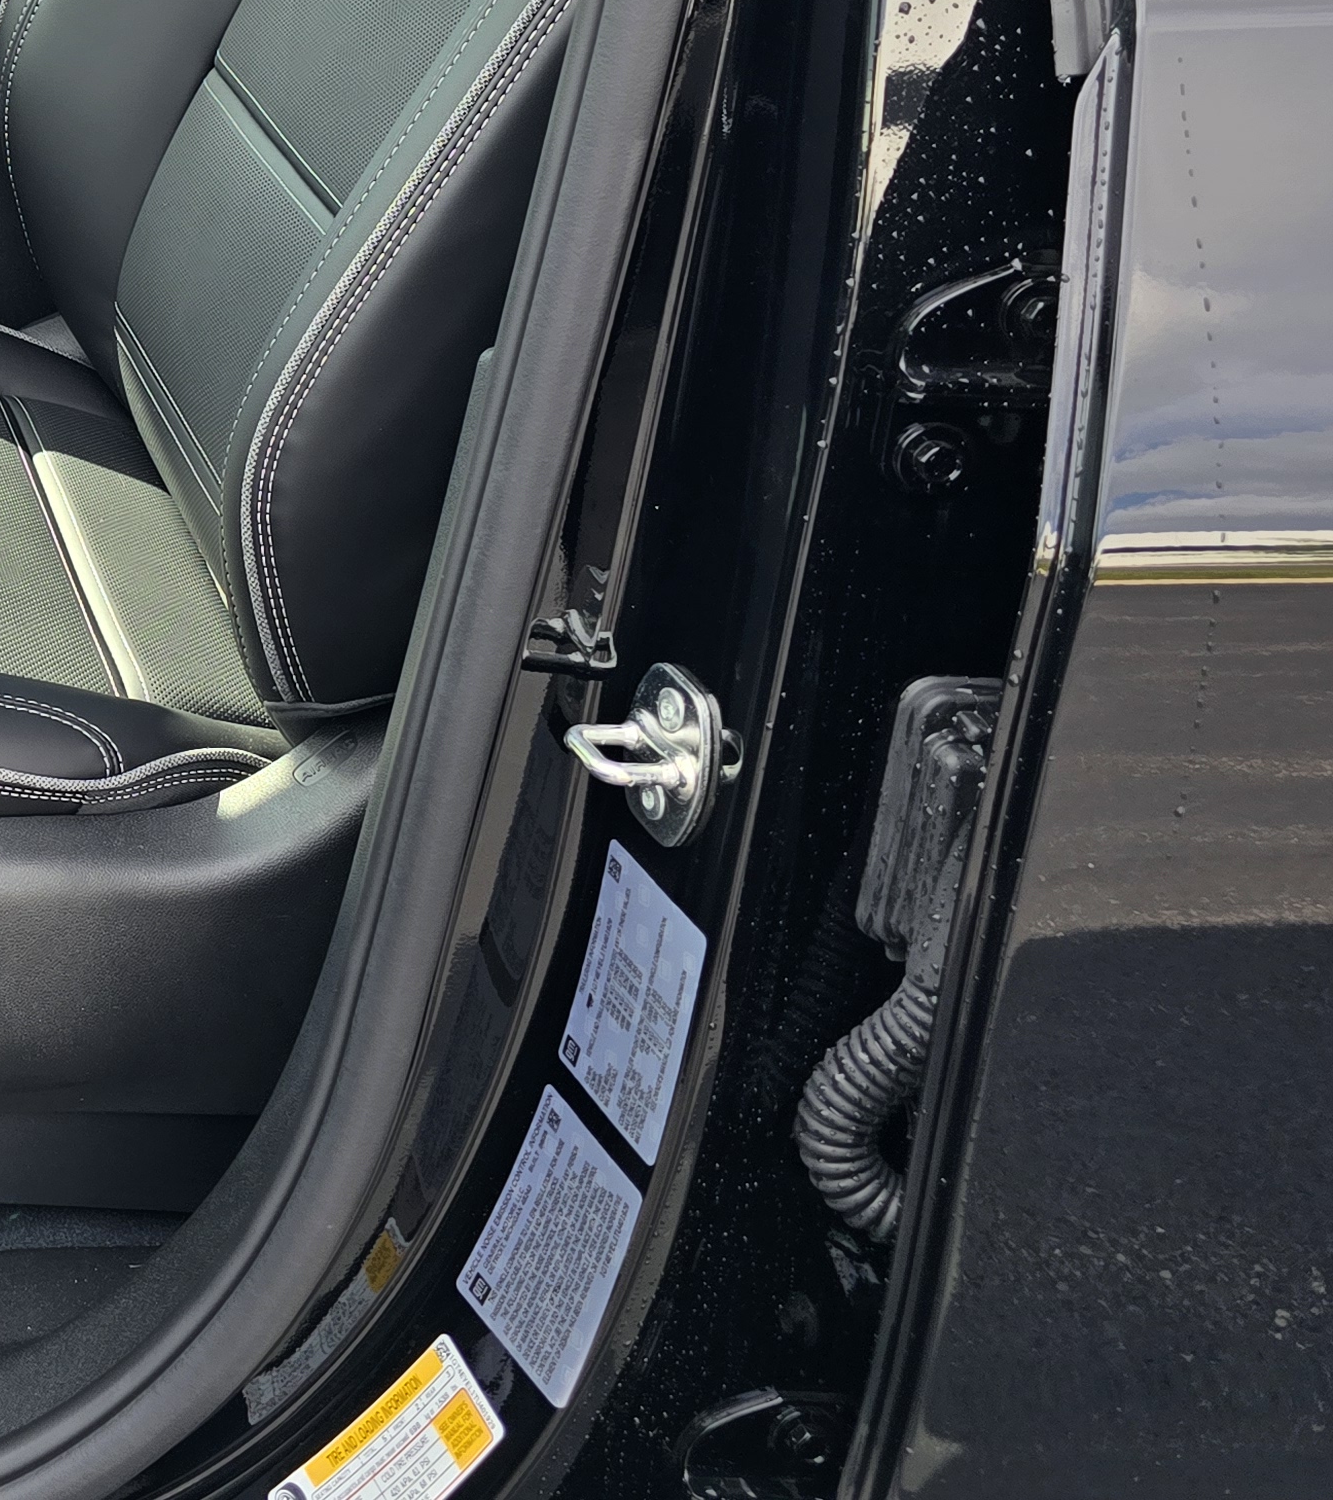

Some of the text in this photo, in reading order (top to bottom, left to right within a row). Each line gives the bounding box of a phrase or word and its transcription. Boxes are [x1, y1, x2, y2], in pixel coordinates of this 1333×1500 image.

[565, 1037, 577, 1063] gm
[472, 1275, 488, 1302] gm
[325, 1373, 422, 1468] TIRE AND LOADING INFORMATION
